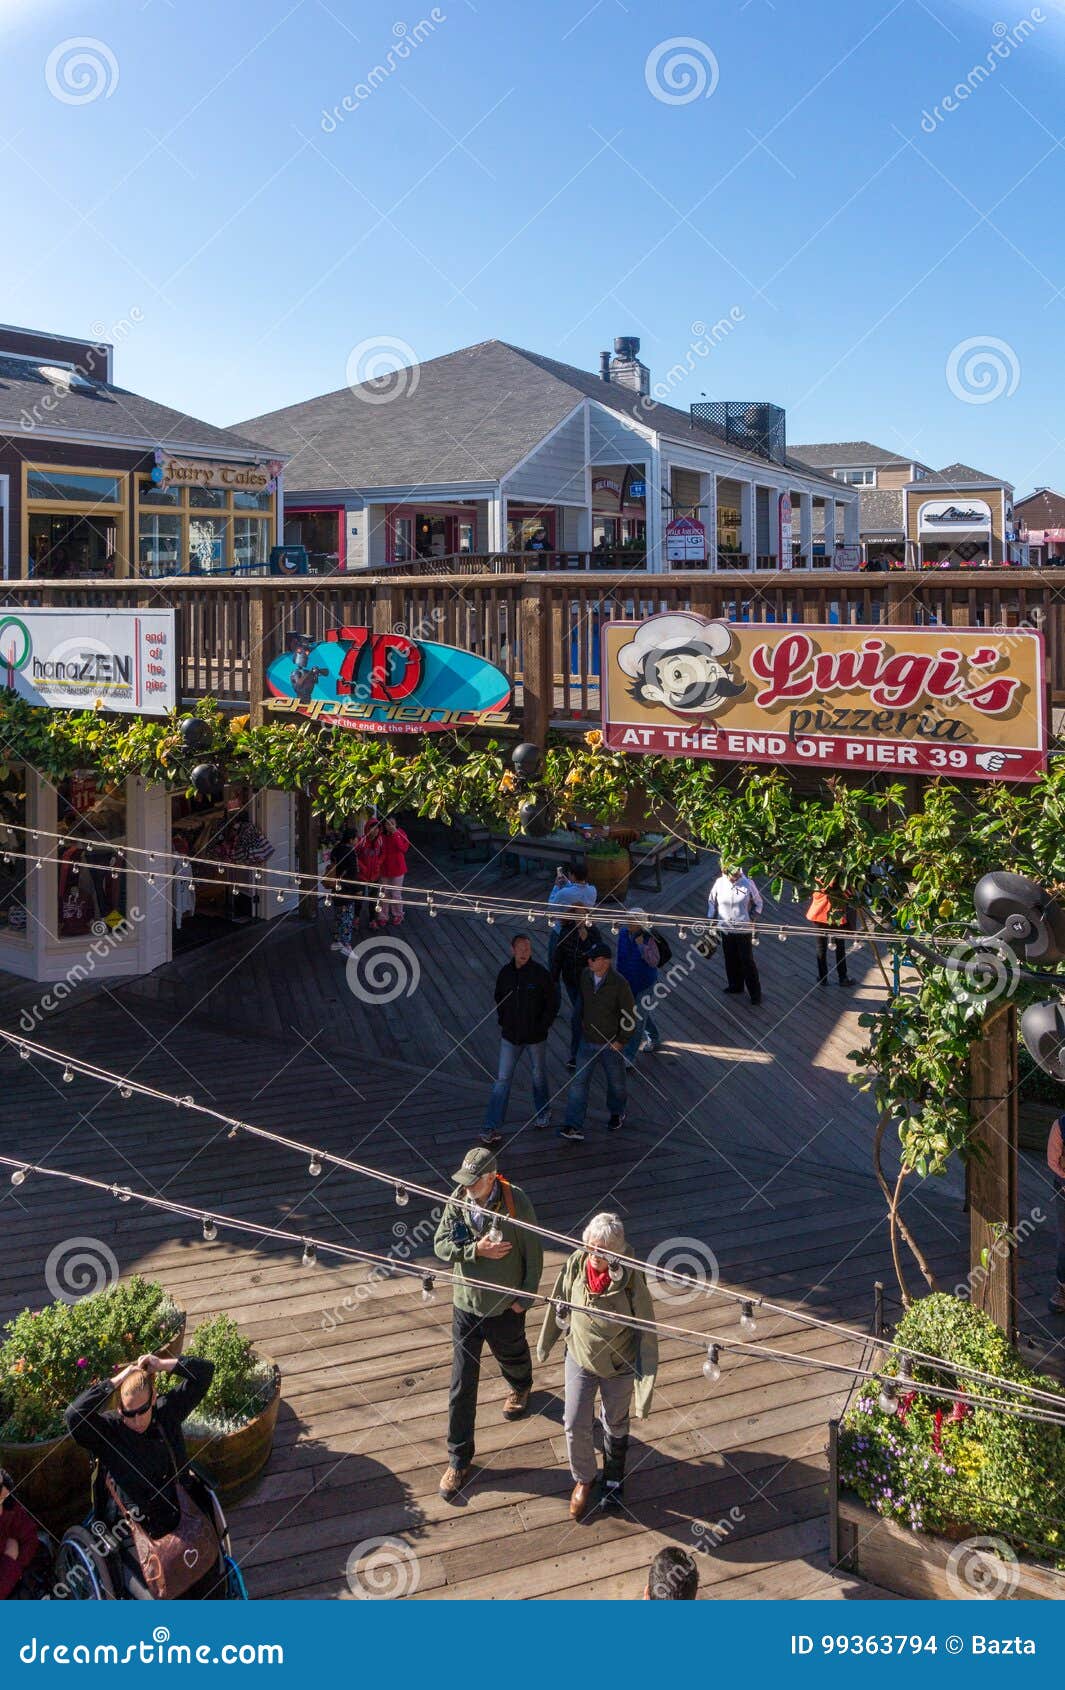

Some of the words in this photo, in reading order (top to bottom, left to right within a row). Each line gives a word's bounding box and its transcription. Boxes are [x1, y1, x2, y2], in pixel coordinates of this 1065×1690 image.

[219, 467, 267, 486] Tales
[145, 632, 163, 642] end
[149, 648, 160, 657] of
[147, 663, 162, 673] the
[325, 626, 422, 701] 7D
[750, 632, 1021, 715] Luigi's
[145, 679, 164, 691] pier
[343, 719, 357, 728] the
[359, 722, 375, 732] end
[377, 723, 386, 732] of
[789, 699, 969, 741] pizzeria
[622, 729, 655, 746] AT
[663, 731, 718, 751] THE
[728, 736, 787, 756] END
[796, 740, 835, 758] OF
[846, 745, 919, 766] PIER
[928, 748, 968, 768] 39
